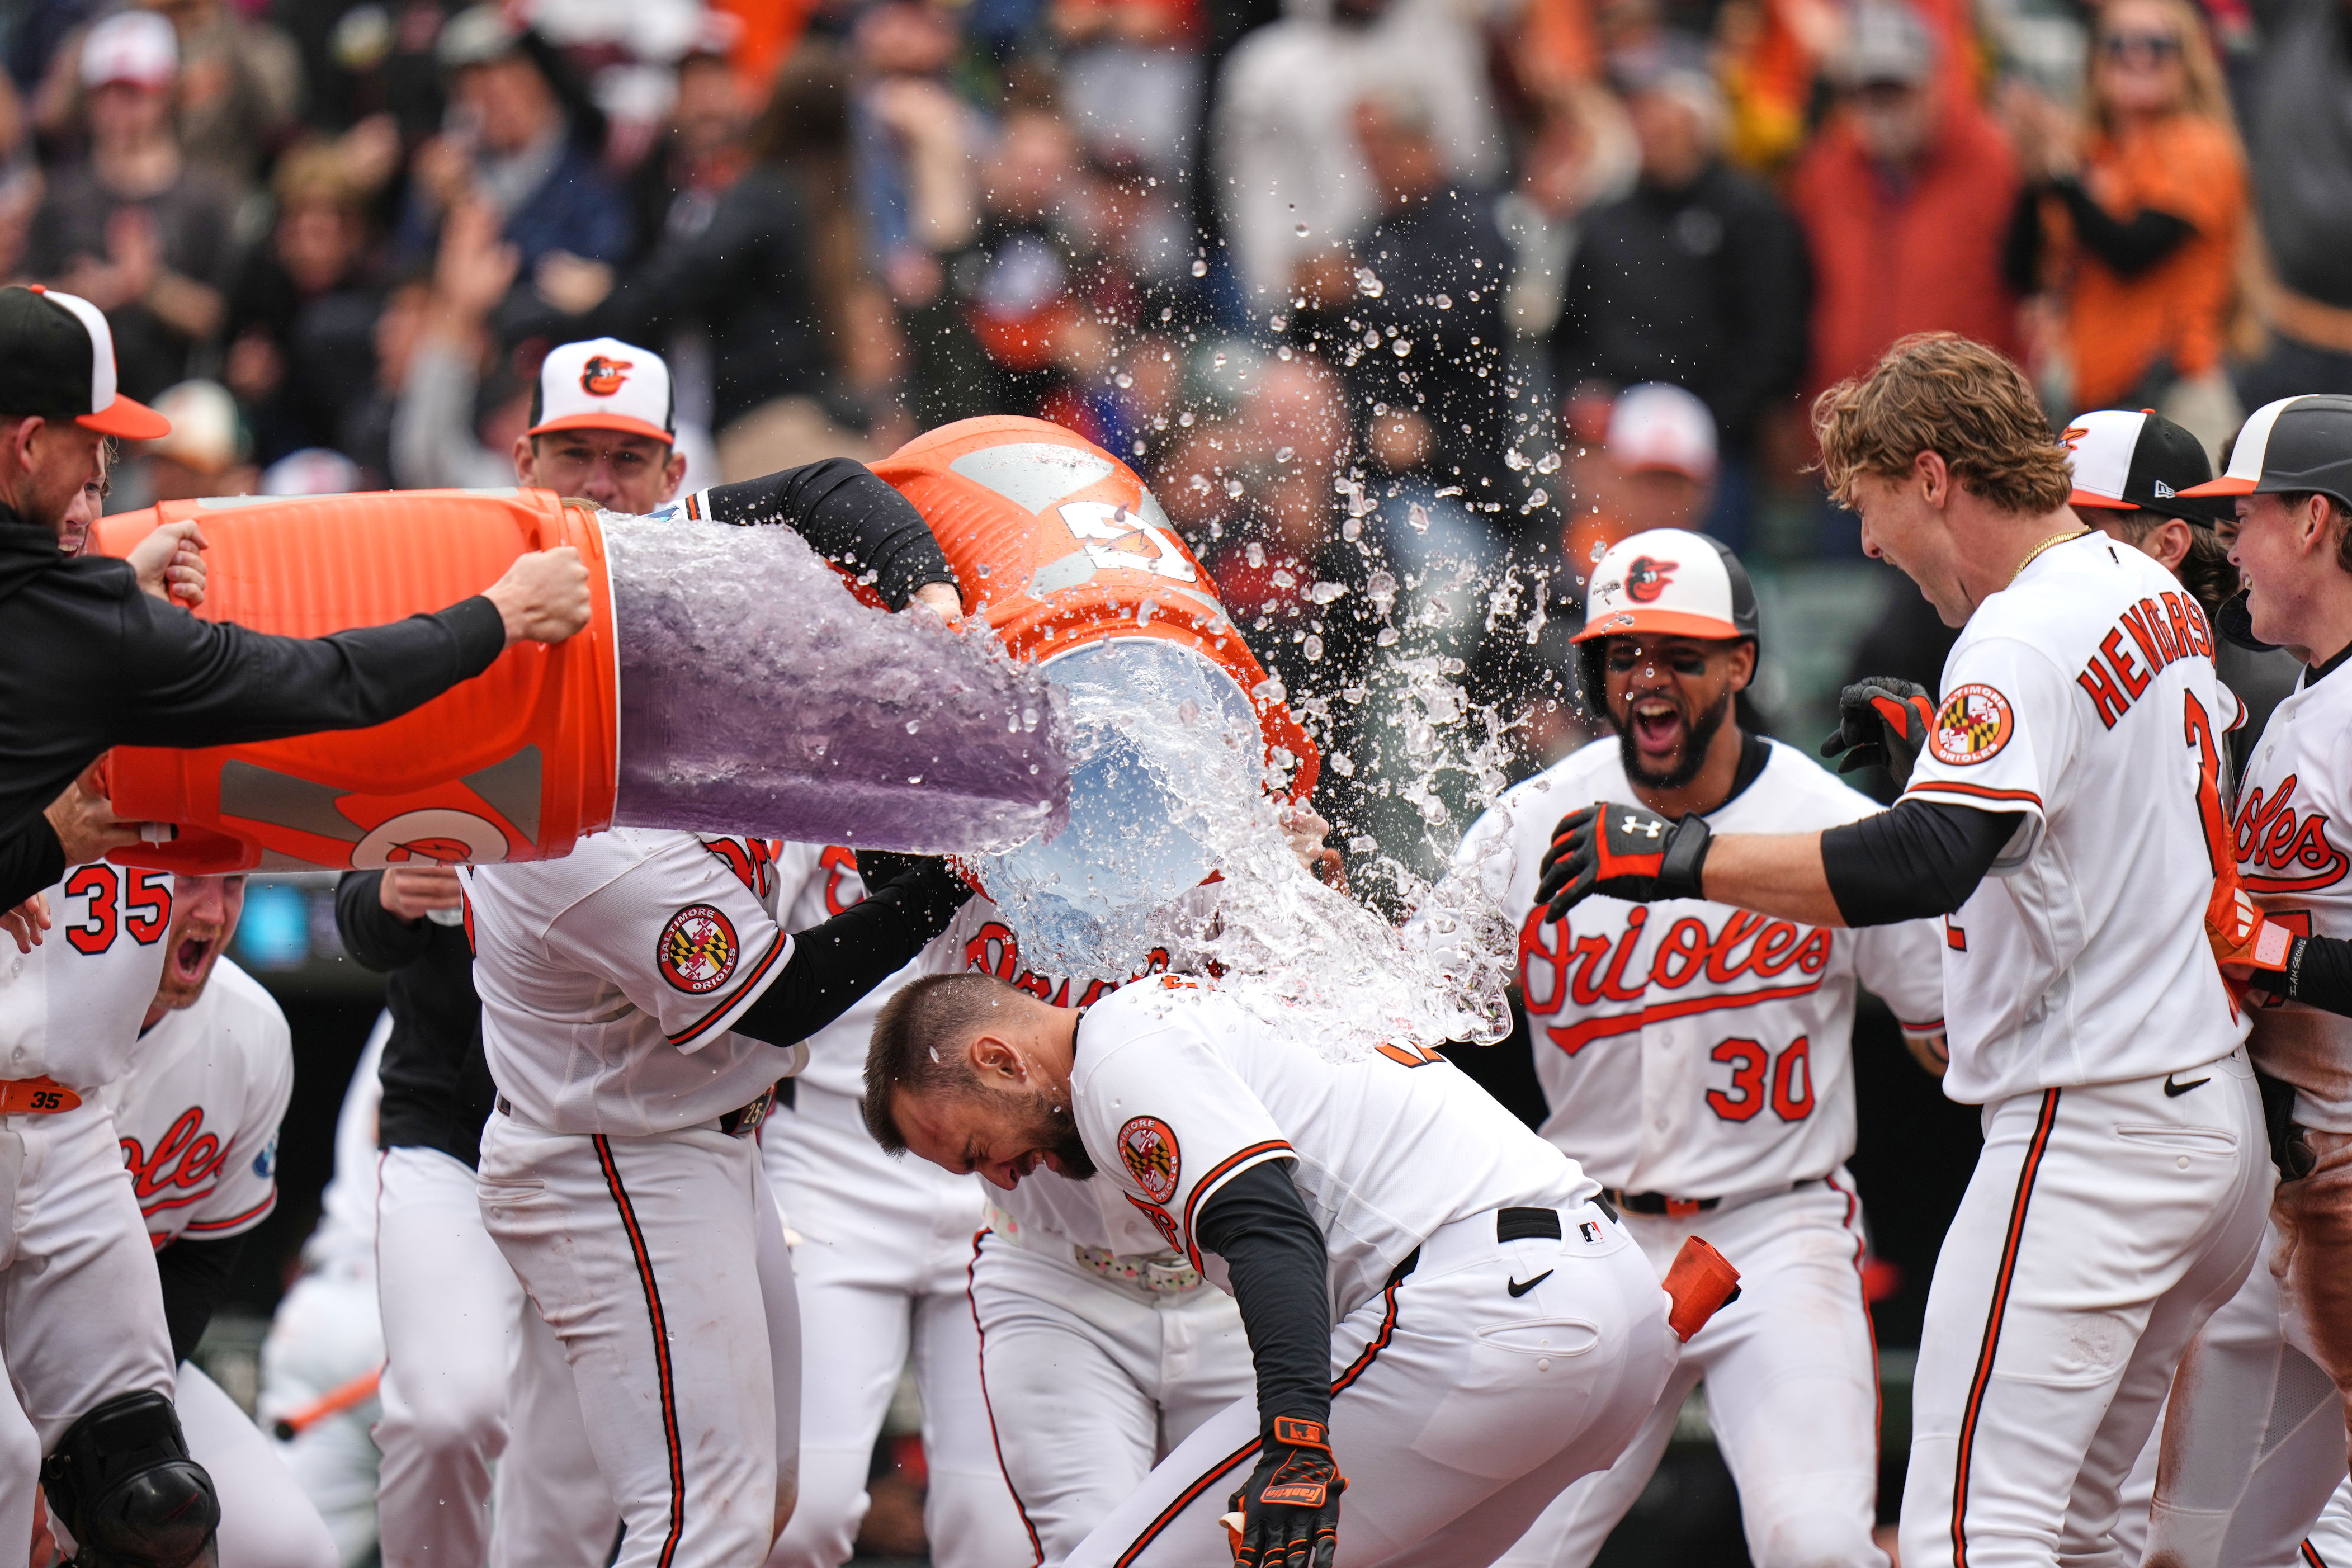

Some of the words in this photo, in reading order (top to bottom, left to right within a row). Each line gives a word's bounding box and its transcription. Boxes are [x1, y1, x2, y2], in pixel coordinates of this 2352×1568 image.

[1935, 685, 2008, 722] BALTIMORE
[1938, 742, 1998, 763] ORIOLES
[65, 863, 173, 956] 35
[661, 908, 715, 963] BALTIMORE
[2293, 939, 2306, 969] SECOND
[692, 947, 736, 990] ORIOLES
[1518, 901, 1833, 1015] Orioles
[2290, 970, 2298, 985] AM
[30, 1091, 63, 1109] 35
[1706, 1036, 1816, 1123] 30
[744, 1102, 763, 1123] 25
[1119, 1119, 1156, 1176] BALTIMORE
[1155, 1155, 1178, 1201] ORIOLES
